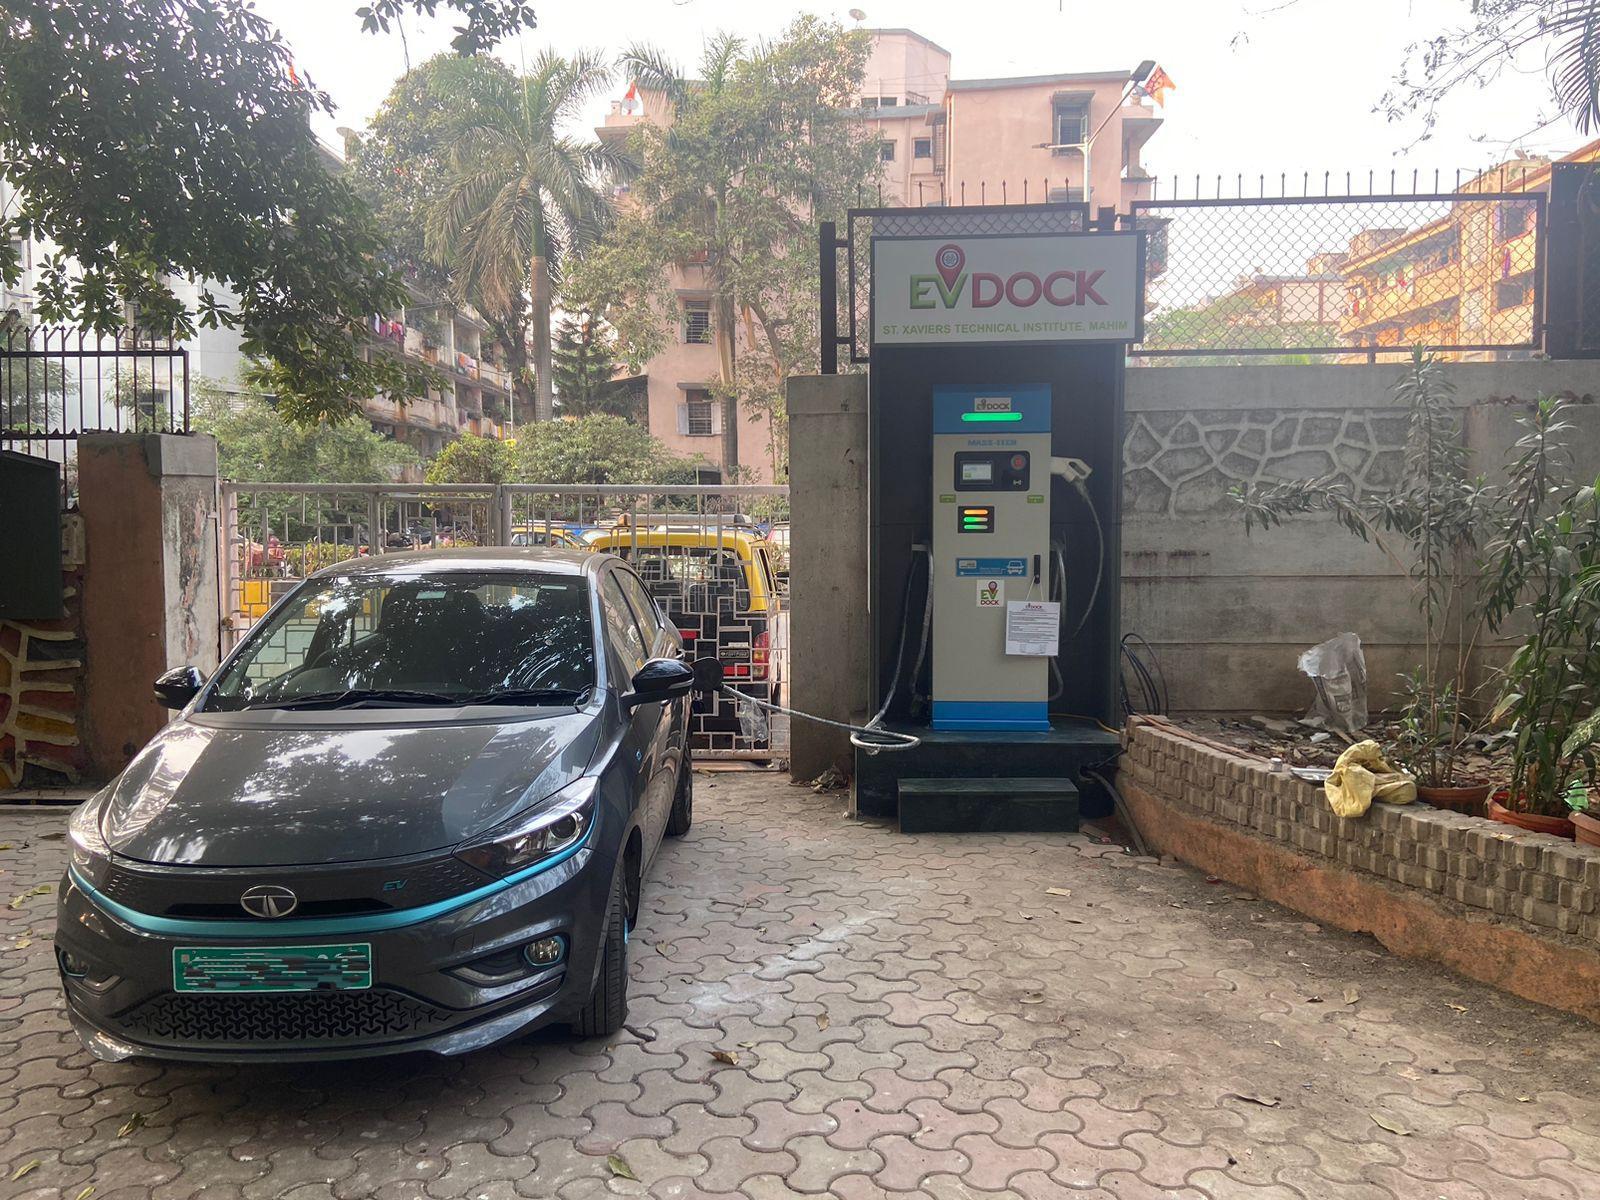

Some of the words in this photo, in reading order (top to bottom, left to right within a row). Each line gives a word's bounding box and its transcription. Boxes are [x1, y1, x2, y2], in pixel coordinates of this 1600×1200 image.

[910, 270, 1108, 309] EVDOCK
[883, 325, 899, 335] ST.
[902, 324, 951, 335] XAVIERS
[954, 323, 1020, 334] TECHNICAL
[1089, 320, 1128, 331] MAHIM
[981, 589, 998, 599] EV
[383, 879, 408, 890] EV
